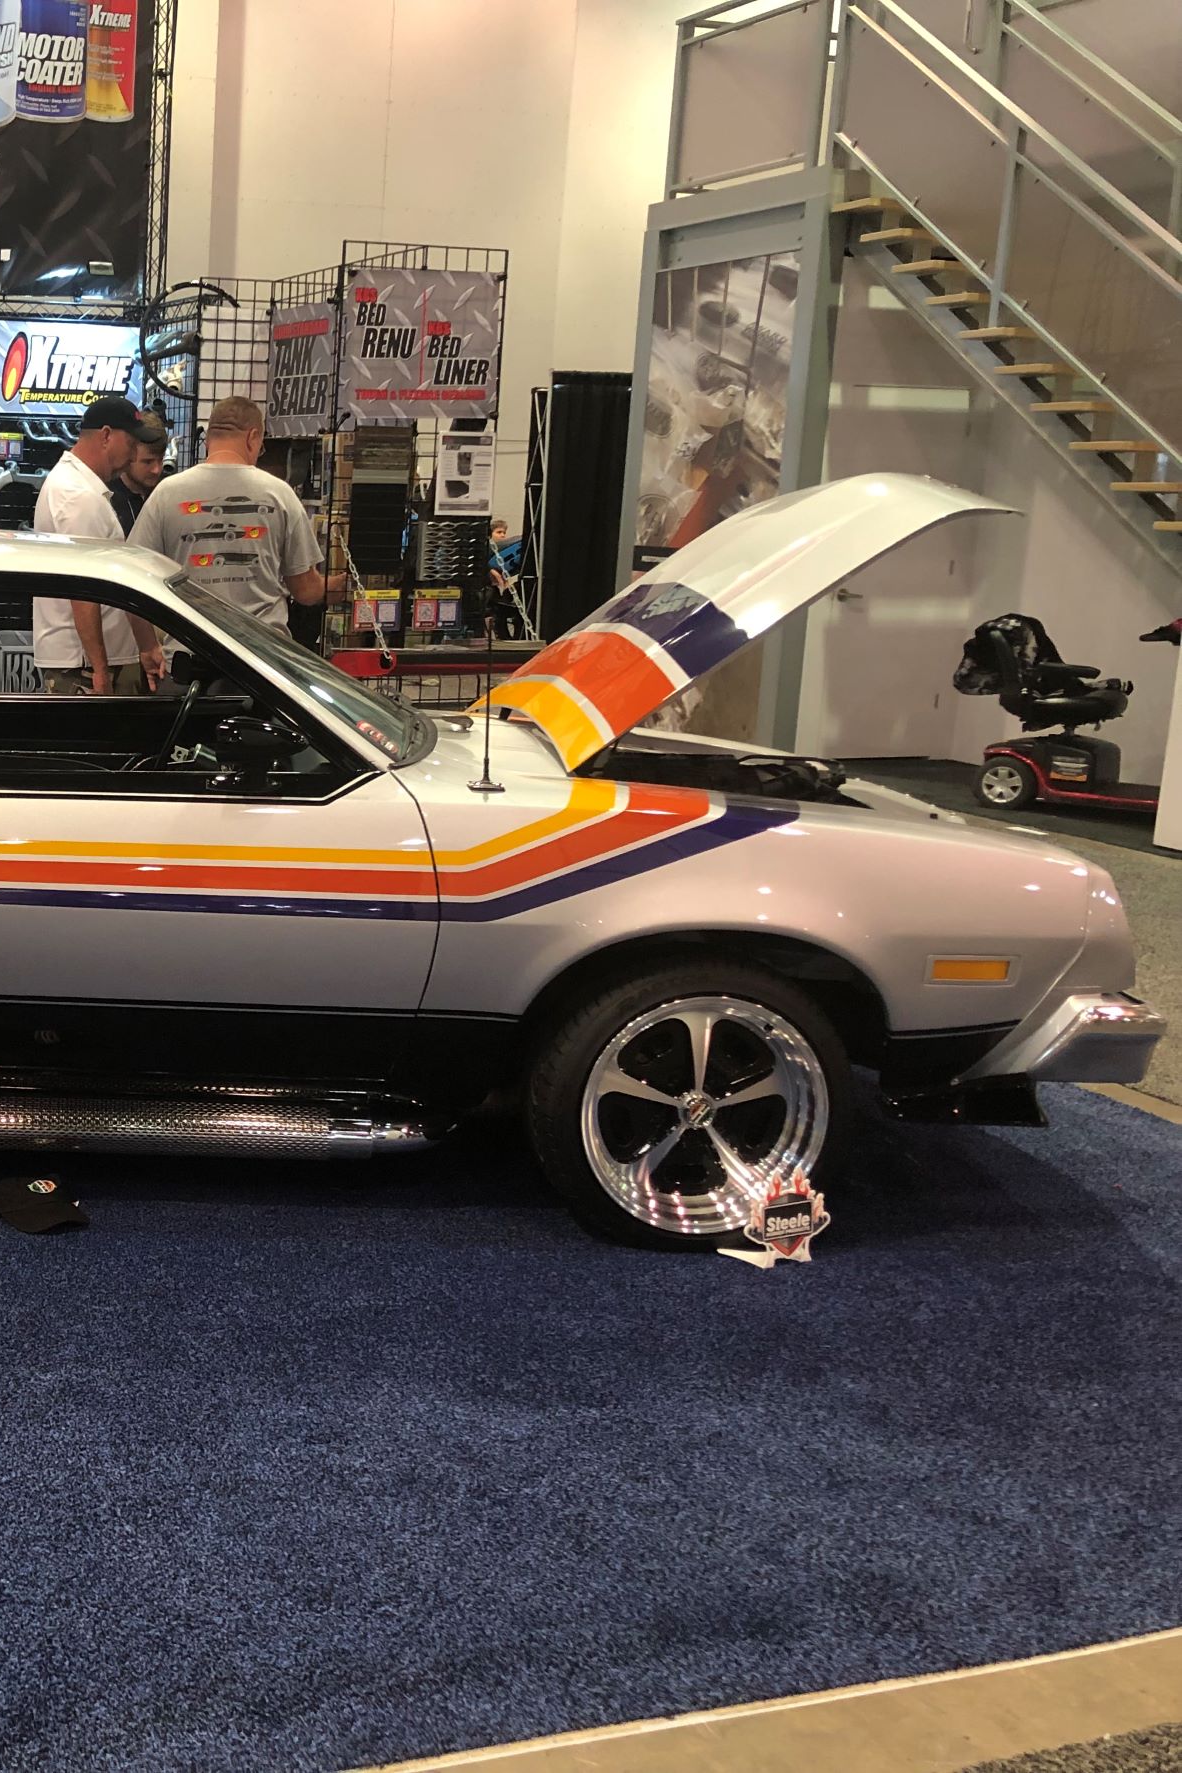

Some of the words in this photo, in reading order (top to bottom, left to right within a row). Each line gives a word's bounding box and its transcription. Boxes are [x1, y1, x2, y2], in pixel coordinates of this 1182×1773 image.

[90, 4, 132, 28] XTREME
[18, 32, 85, 61] MOTOR
[17, 57, 84, 86] COATER
[356, 302, 386, 326] BED
[274, 336, 316, 377] TANK
[361, 327, 416, 360] RENU
[427, 335, 461, 358] BED
[22, 335, 133, 394] XTREME
[433, 359, 490, 386] LINER
[19, 388, 124, 406] TEMPERATURECO
[269, 374, 329, 417] SEALER
[767, 1213, 810, 1232] Steele
